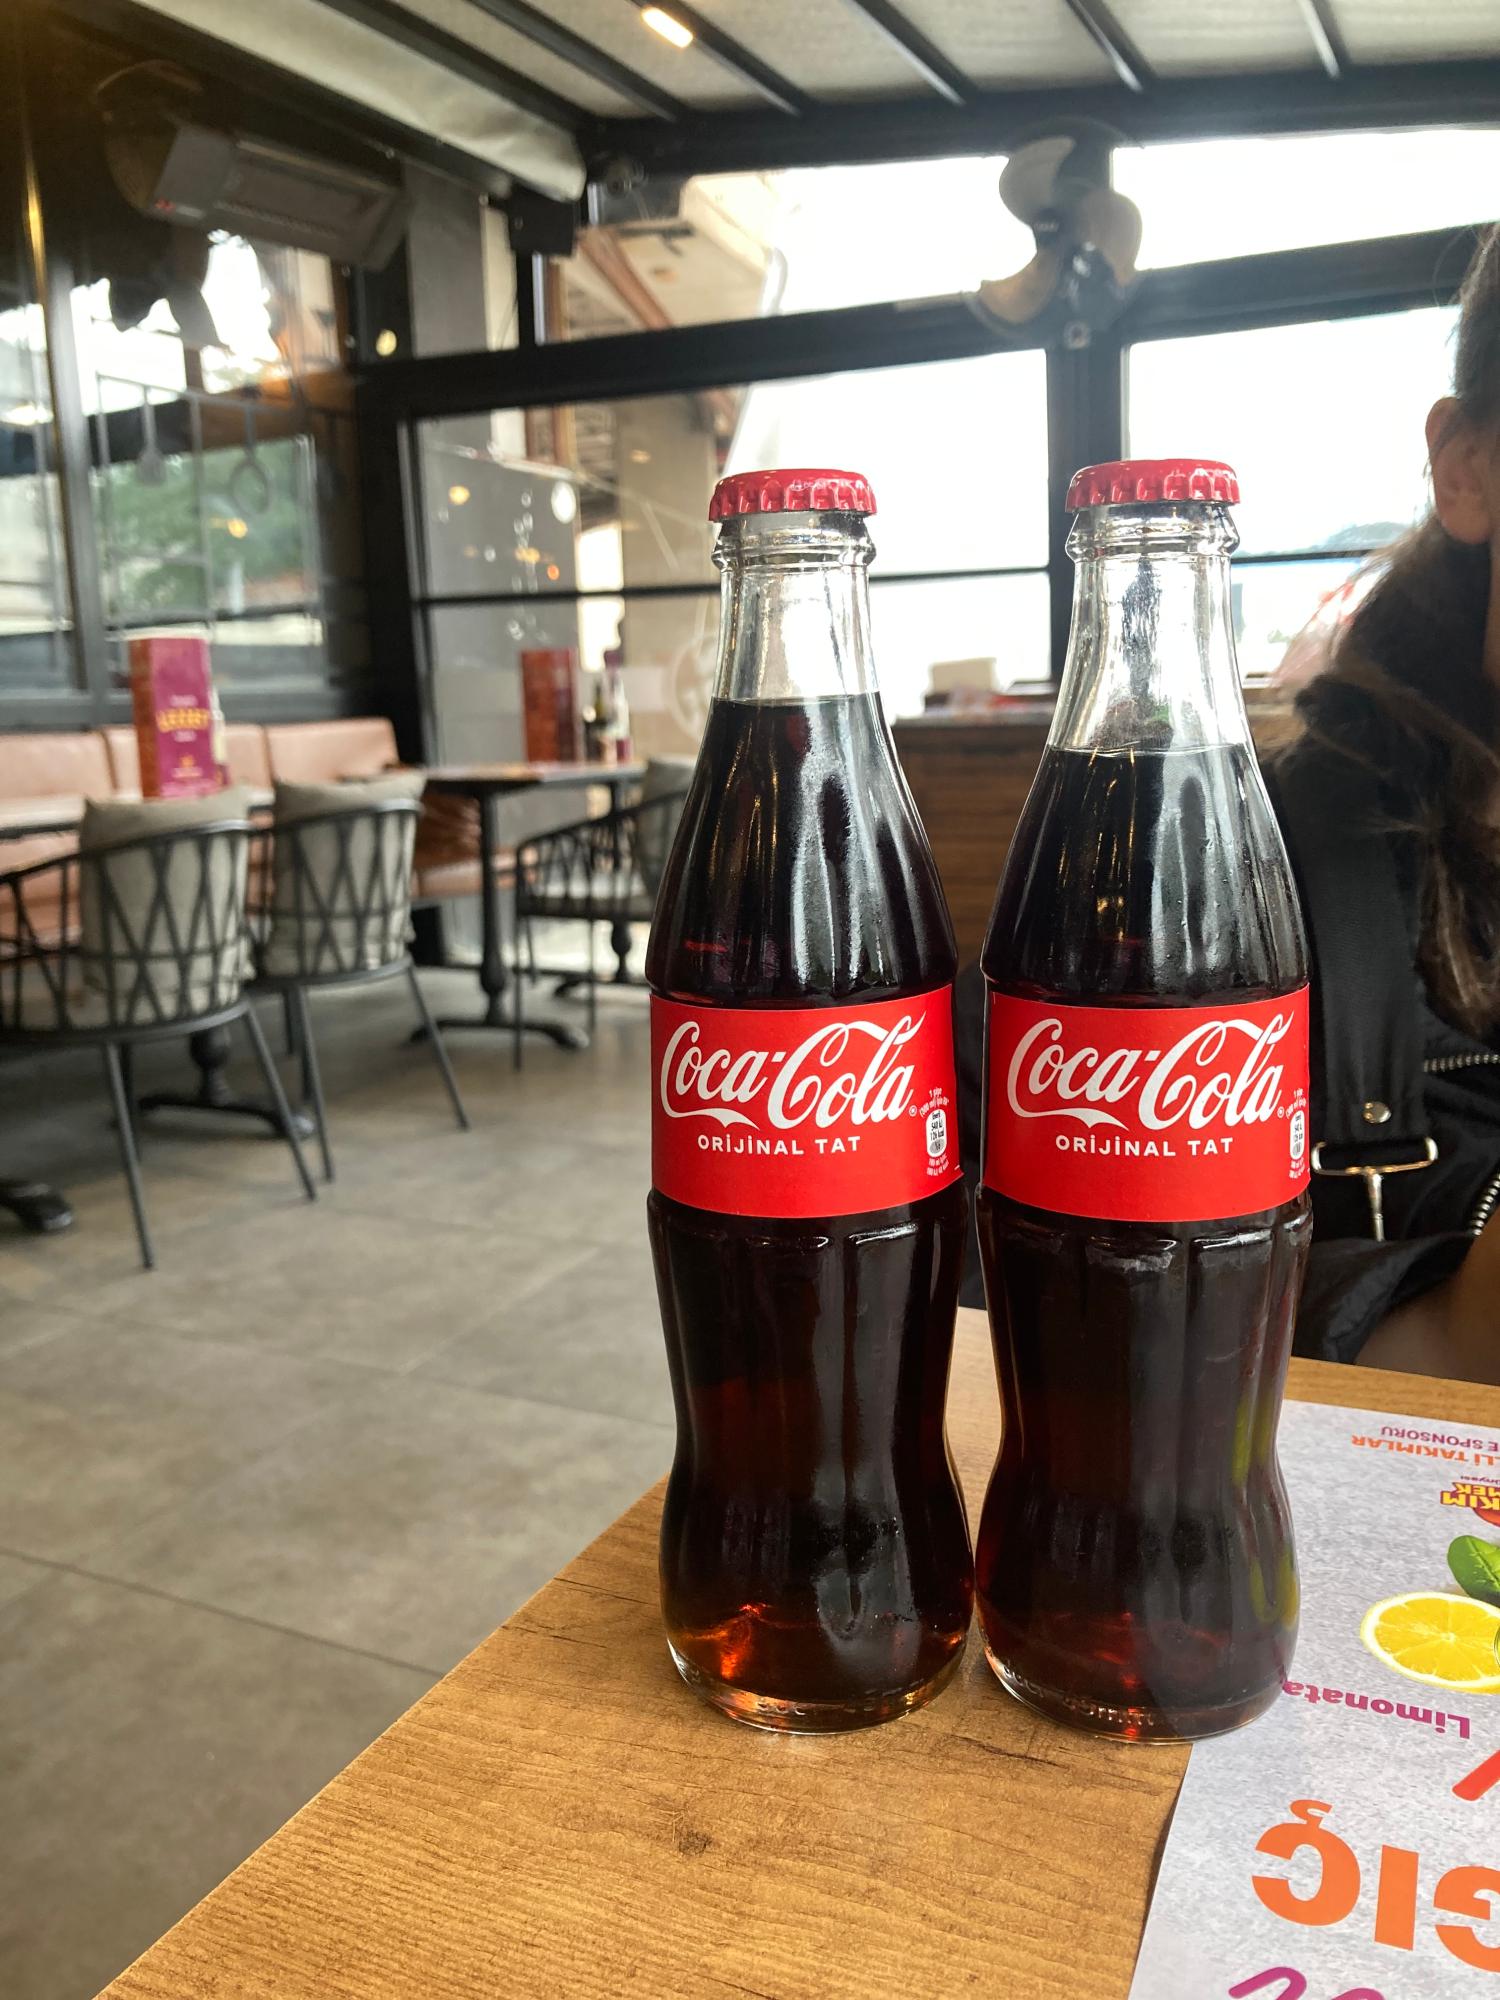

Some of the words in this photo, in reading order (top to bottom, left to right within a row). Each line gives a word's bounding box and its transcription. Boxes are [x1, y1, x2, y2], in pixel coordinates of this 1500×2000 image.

[660, 1011, 927, 1130] Coca-Cola
[1006, 1010, 1295, 1131] Coca-Cola
[698, 1134, 805, 1155] ORİJİNAL
[815, 1135, 861, 1154] TAT
[1055, 1134, 1176, 1157] ORİJİNAL
[1187, 1137, 1234, 1154] TAT
[1351, 1435, 1469, 1462] TAKIMLAR
[1381, 1426, 1483, 1450] SPONSORU
[1474, 1453, 1500, 1466] Lİ
[1282, 1680, 1470, 1739] Limonata
